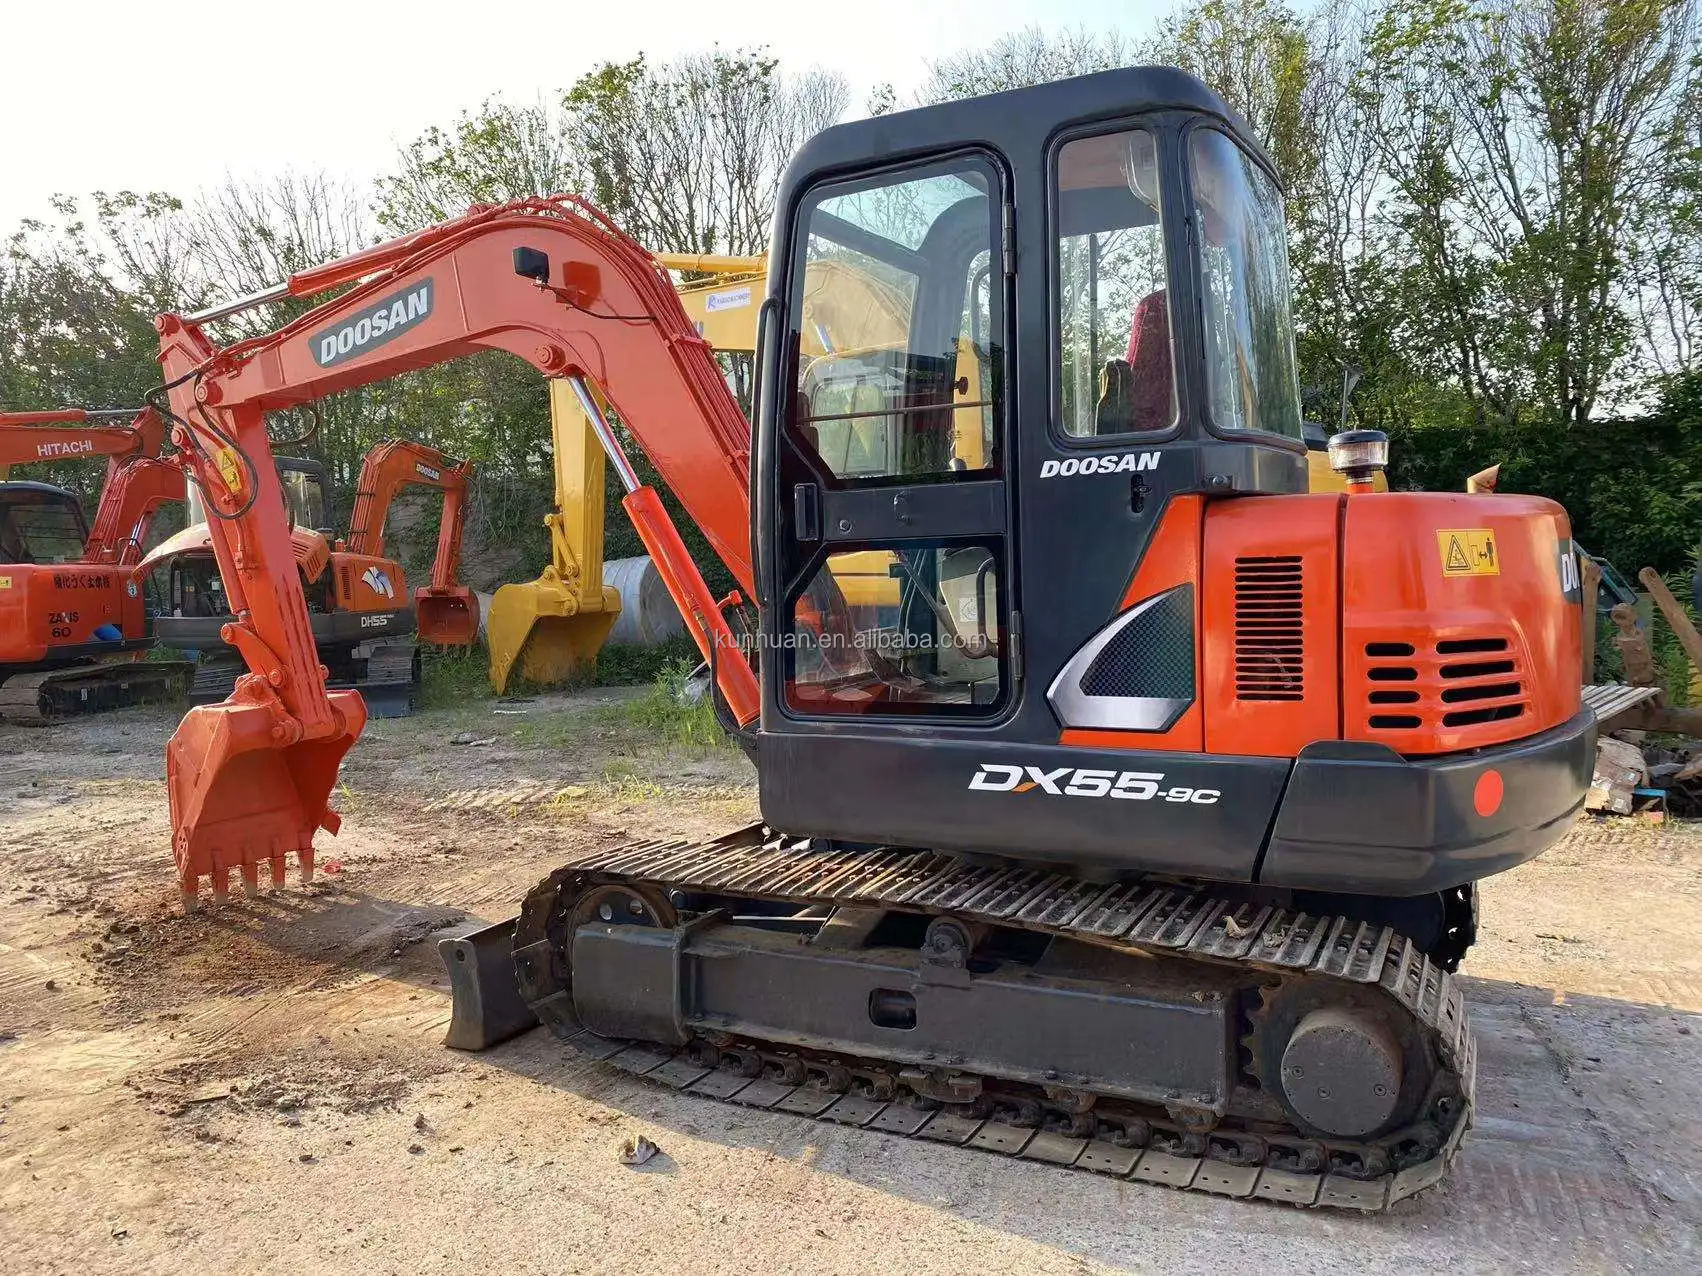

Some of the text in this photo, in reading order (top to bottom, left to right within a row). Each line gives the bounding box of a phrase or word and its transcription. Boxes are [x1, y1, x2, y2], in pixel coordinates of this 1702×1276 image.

[321, 287, 428, 365] DOOSAN
[36, 440, 93, 457] HITACHI
[1040, 451, 1161, 479] DOOSAN
[52, 627, 71, 638] 60
[968, 763, 1221, 804] DX55-9C
